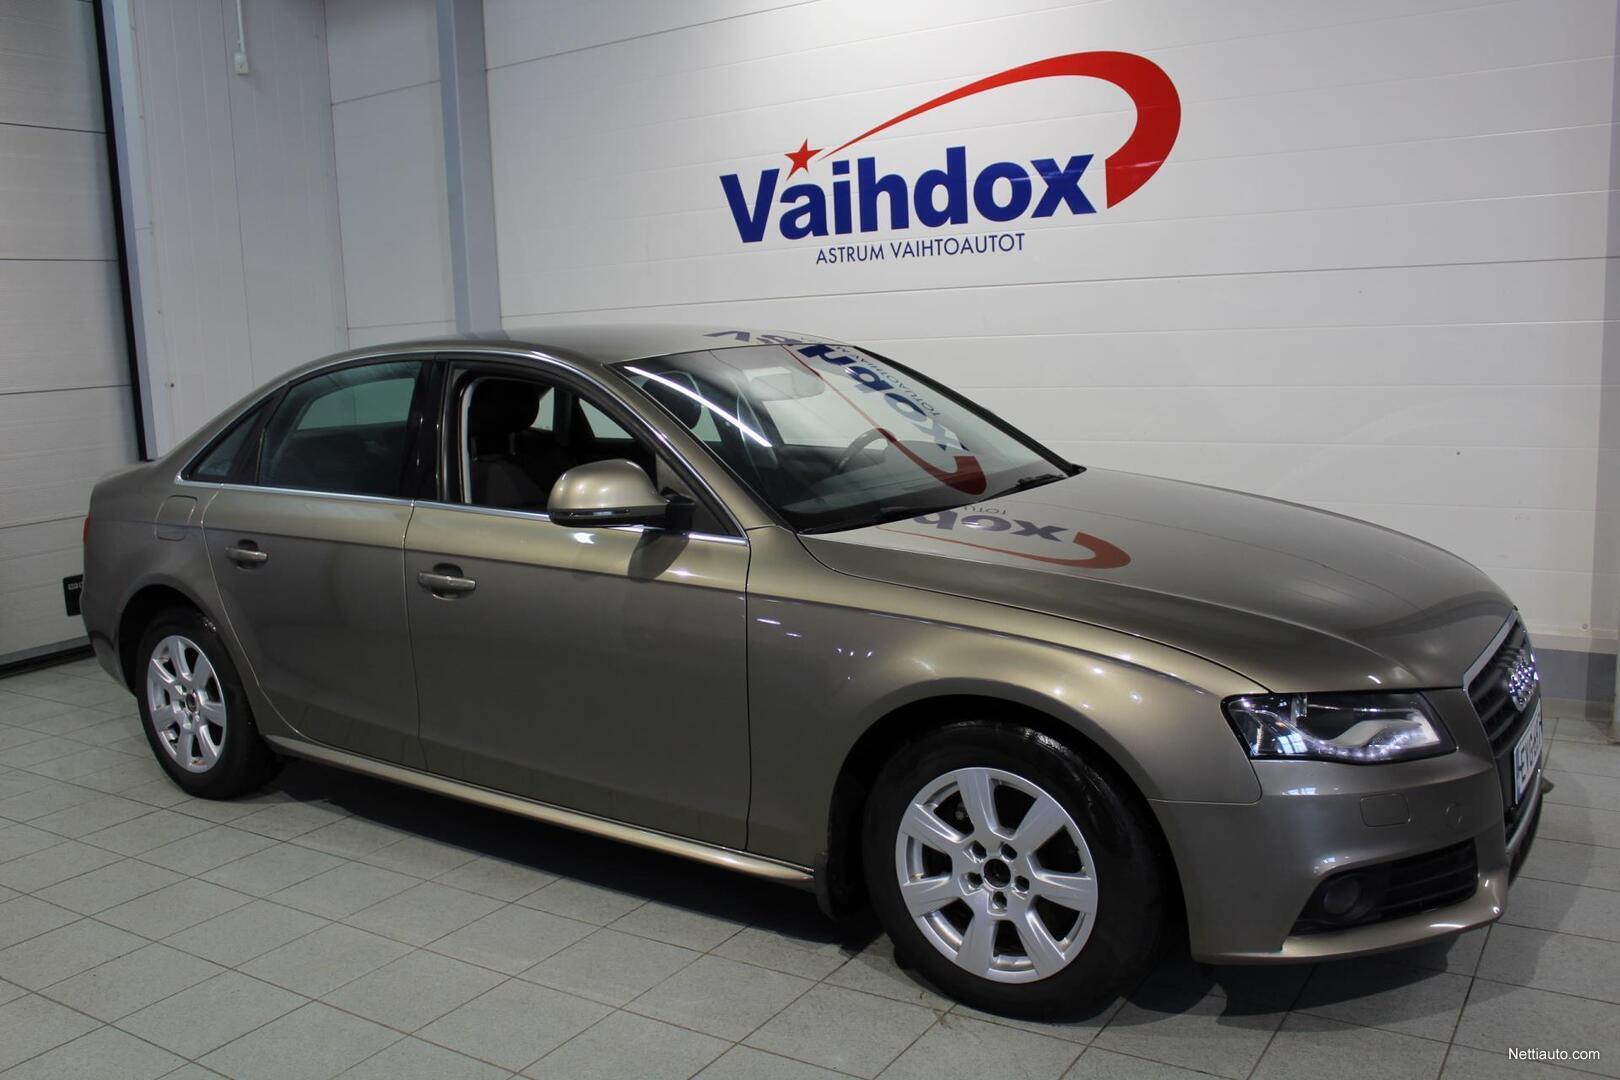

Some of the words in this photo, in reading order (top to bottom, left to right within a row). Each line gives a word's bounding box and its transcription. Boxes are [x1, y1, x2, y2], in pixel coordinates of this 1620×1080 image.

[719, 145, 1097, 243] Vaihdox
[816, 242, 885, 265] ASTRUM
[890, 233, 1025, 258] VAIHTOAUTOT
